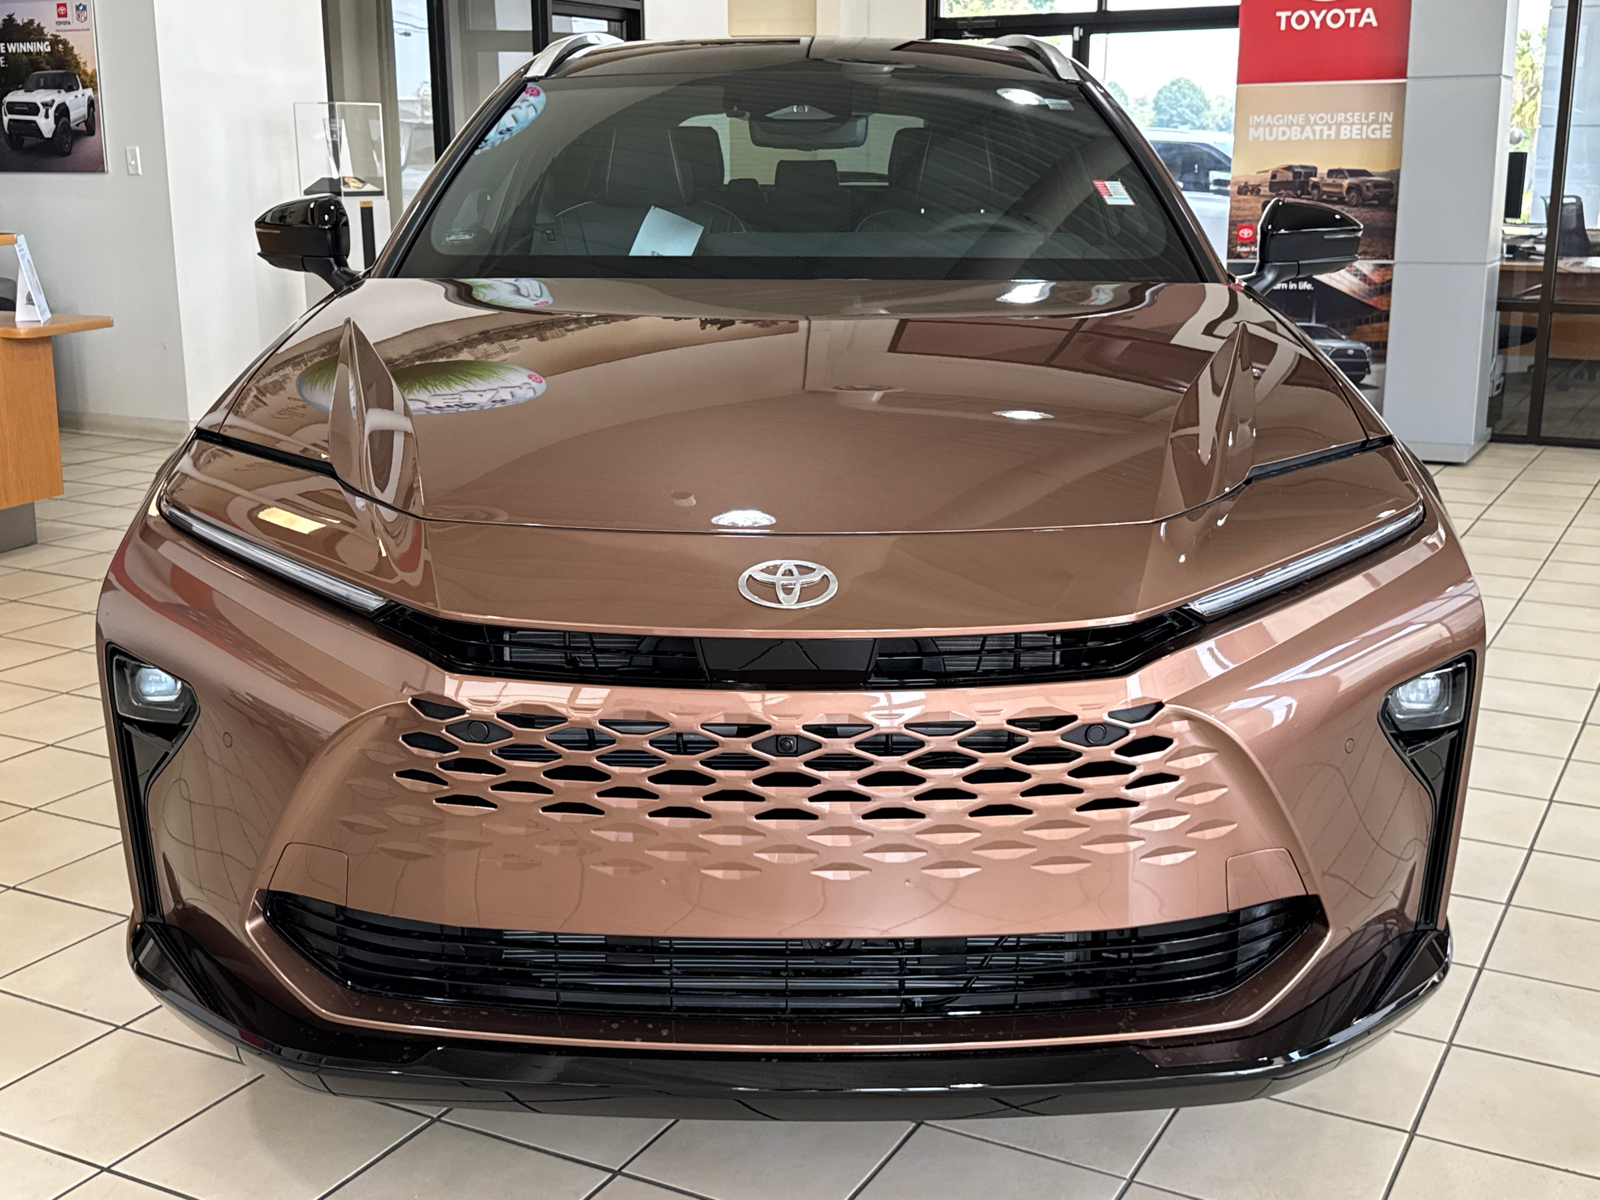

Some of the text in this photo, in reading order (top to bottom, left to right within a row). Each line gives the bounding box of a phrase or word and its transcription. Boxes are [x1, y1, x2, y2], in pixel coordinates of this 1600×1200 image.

[1275, 7, 1378, 31] TOYOTA
[6, 41, 51, 53] WINNING
[1249, 111, 1393, 126] IMAGINE YOURSELF IN
[1248, 124, 1393, 141] MUDBATH BEIGE
[1288, 281, 1297, 290] in
[1298, 281, 1314, 290] life.
